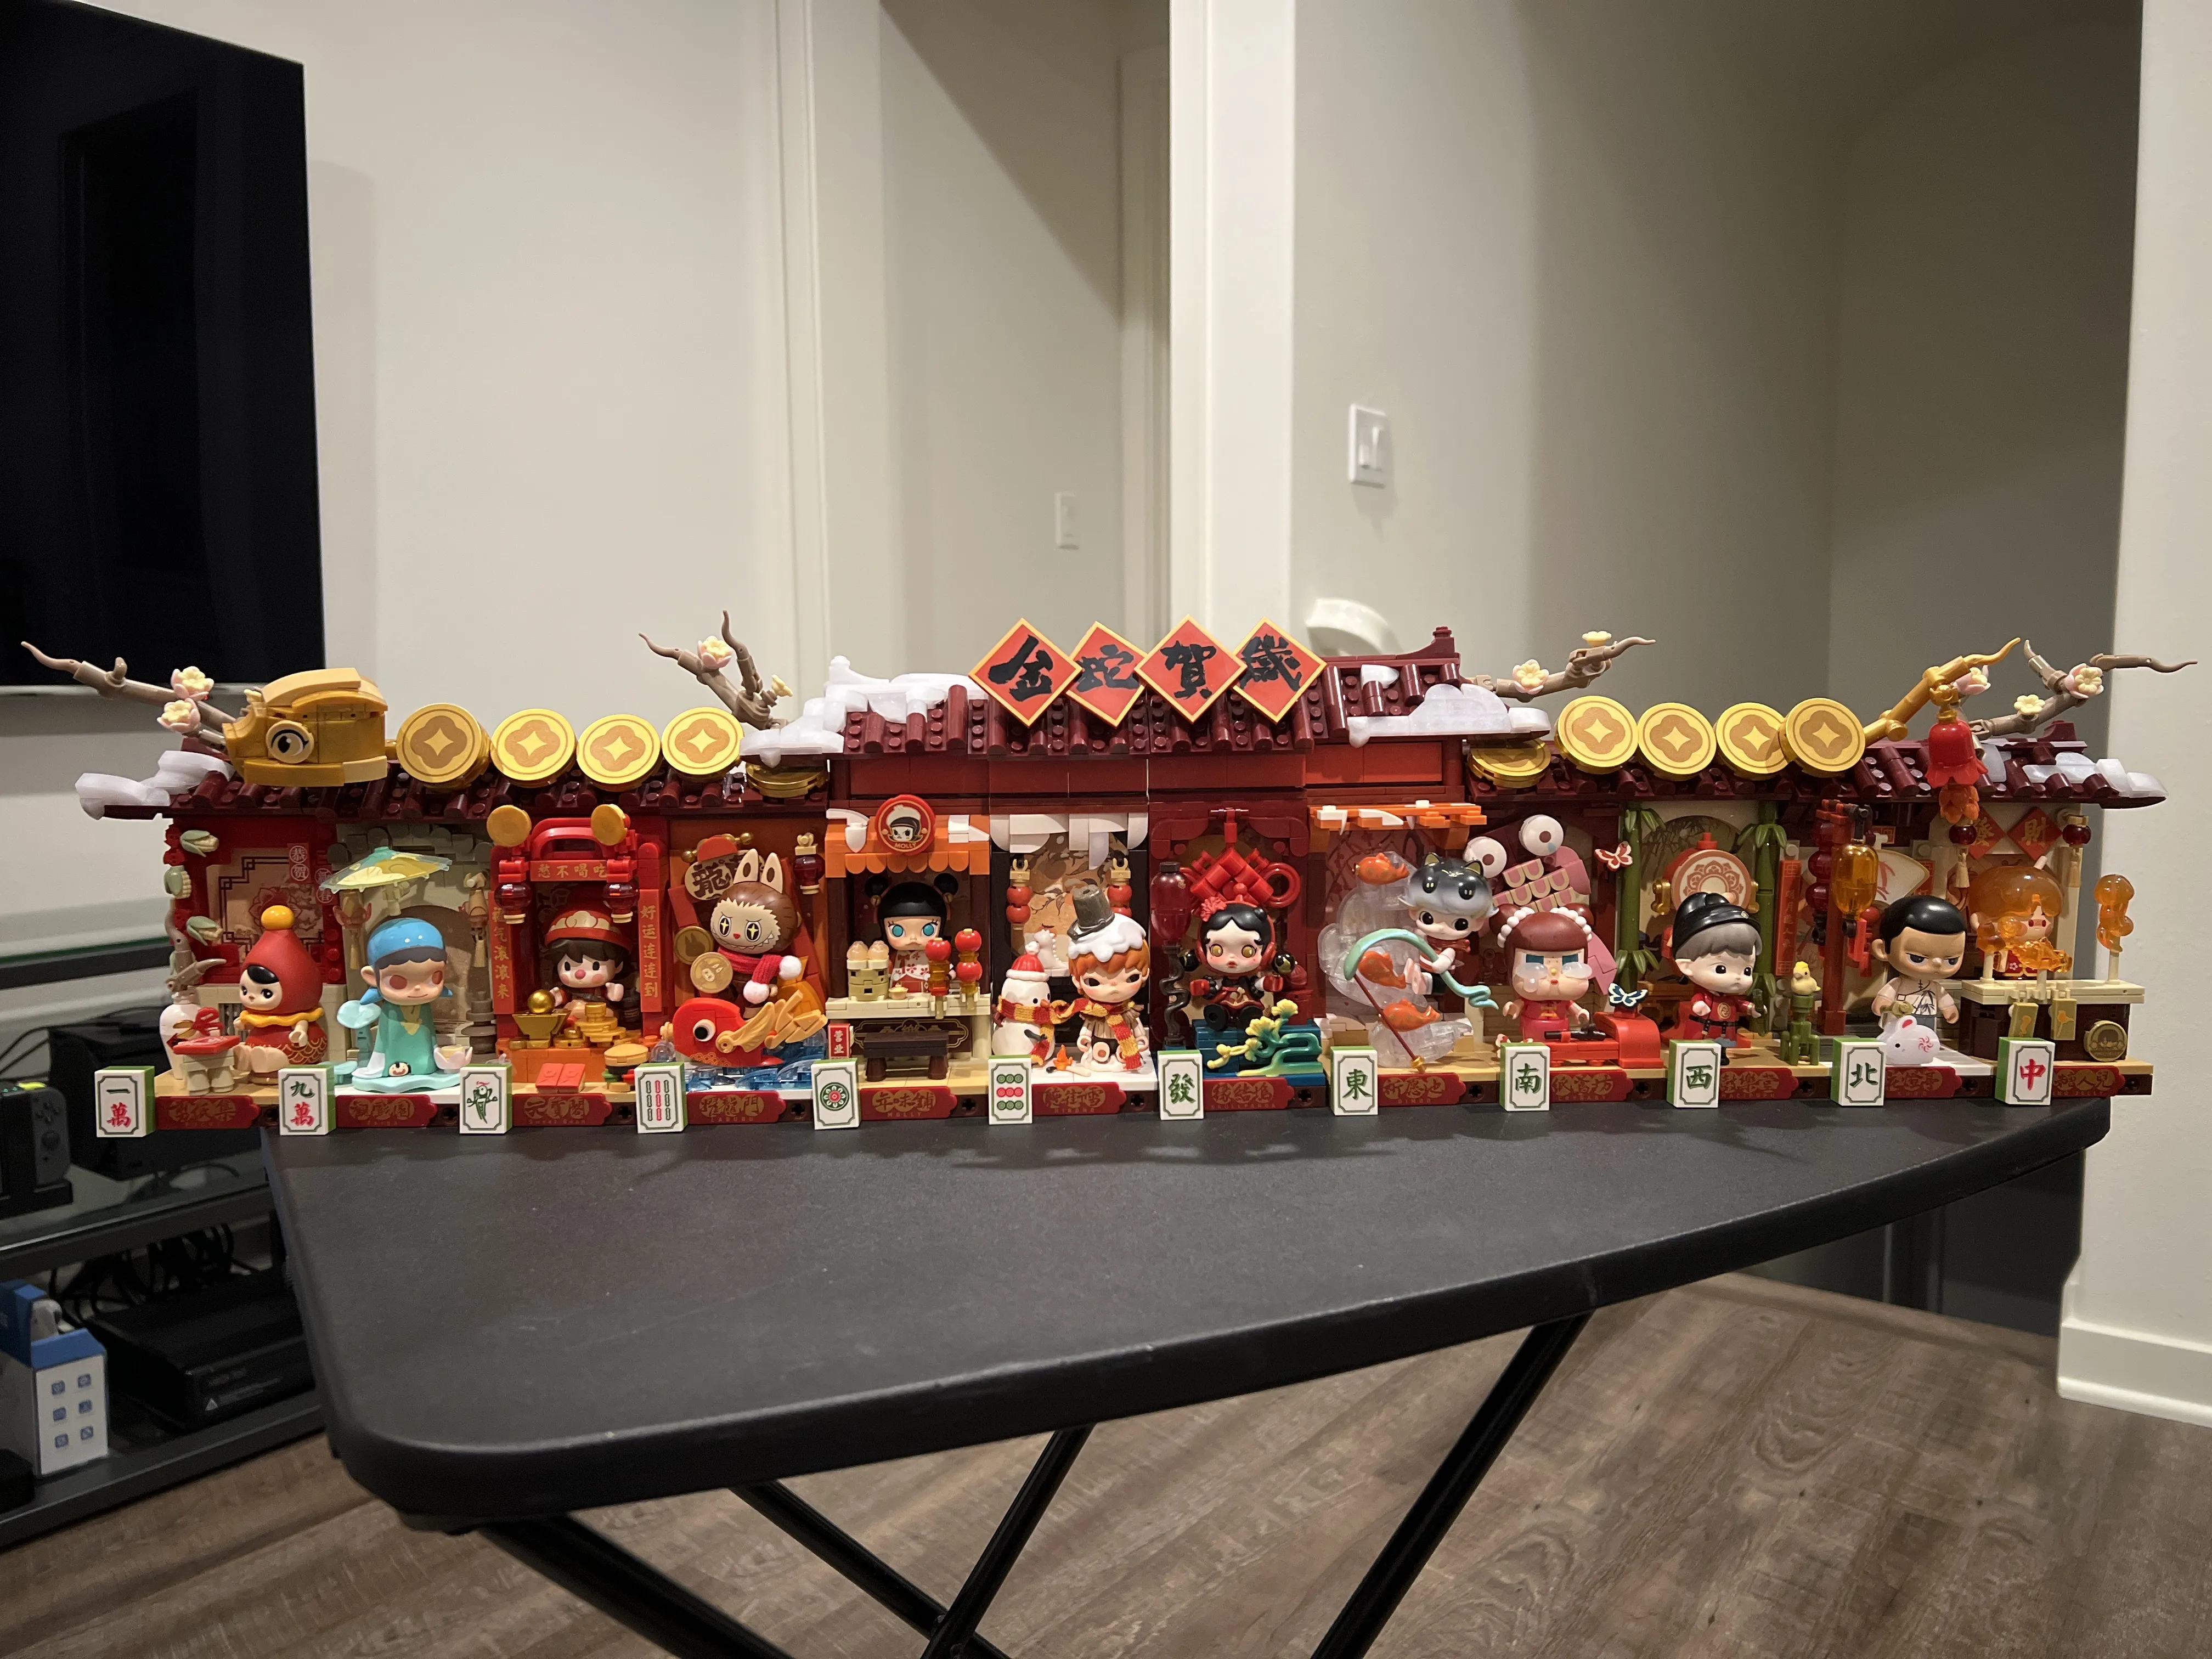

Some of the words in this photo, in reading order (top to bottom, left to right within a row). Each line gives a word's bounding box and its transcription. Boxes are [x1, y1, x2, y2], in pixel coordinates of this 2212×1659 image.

[988, 634, 1302, 703] 金蛇賀歲
[640, 905, 658, 998] 好运连连到
[1167, 1073, 1197, 1105] 發
[1342, 1069, 1371, 1100] 東
[1515, 1063, 1541, 1095] 南
[1685, 1064, 1713, 1090] 西
[1848, 1063, 1879, 1088] 北
[2019, 1058, 2046, 1091] 中
[289, 1080, 315, 1127] 九萬
